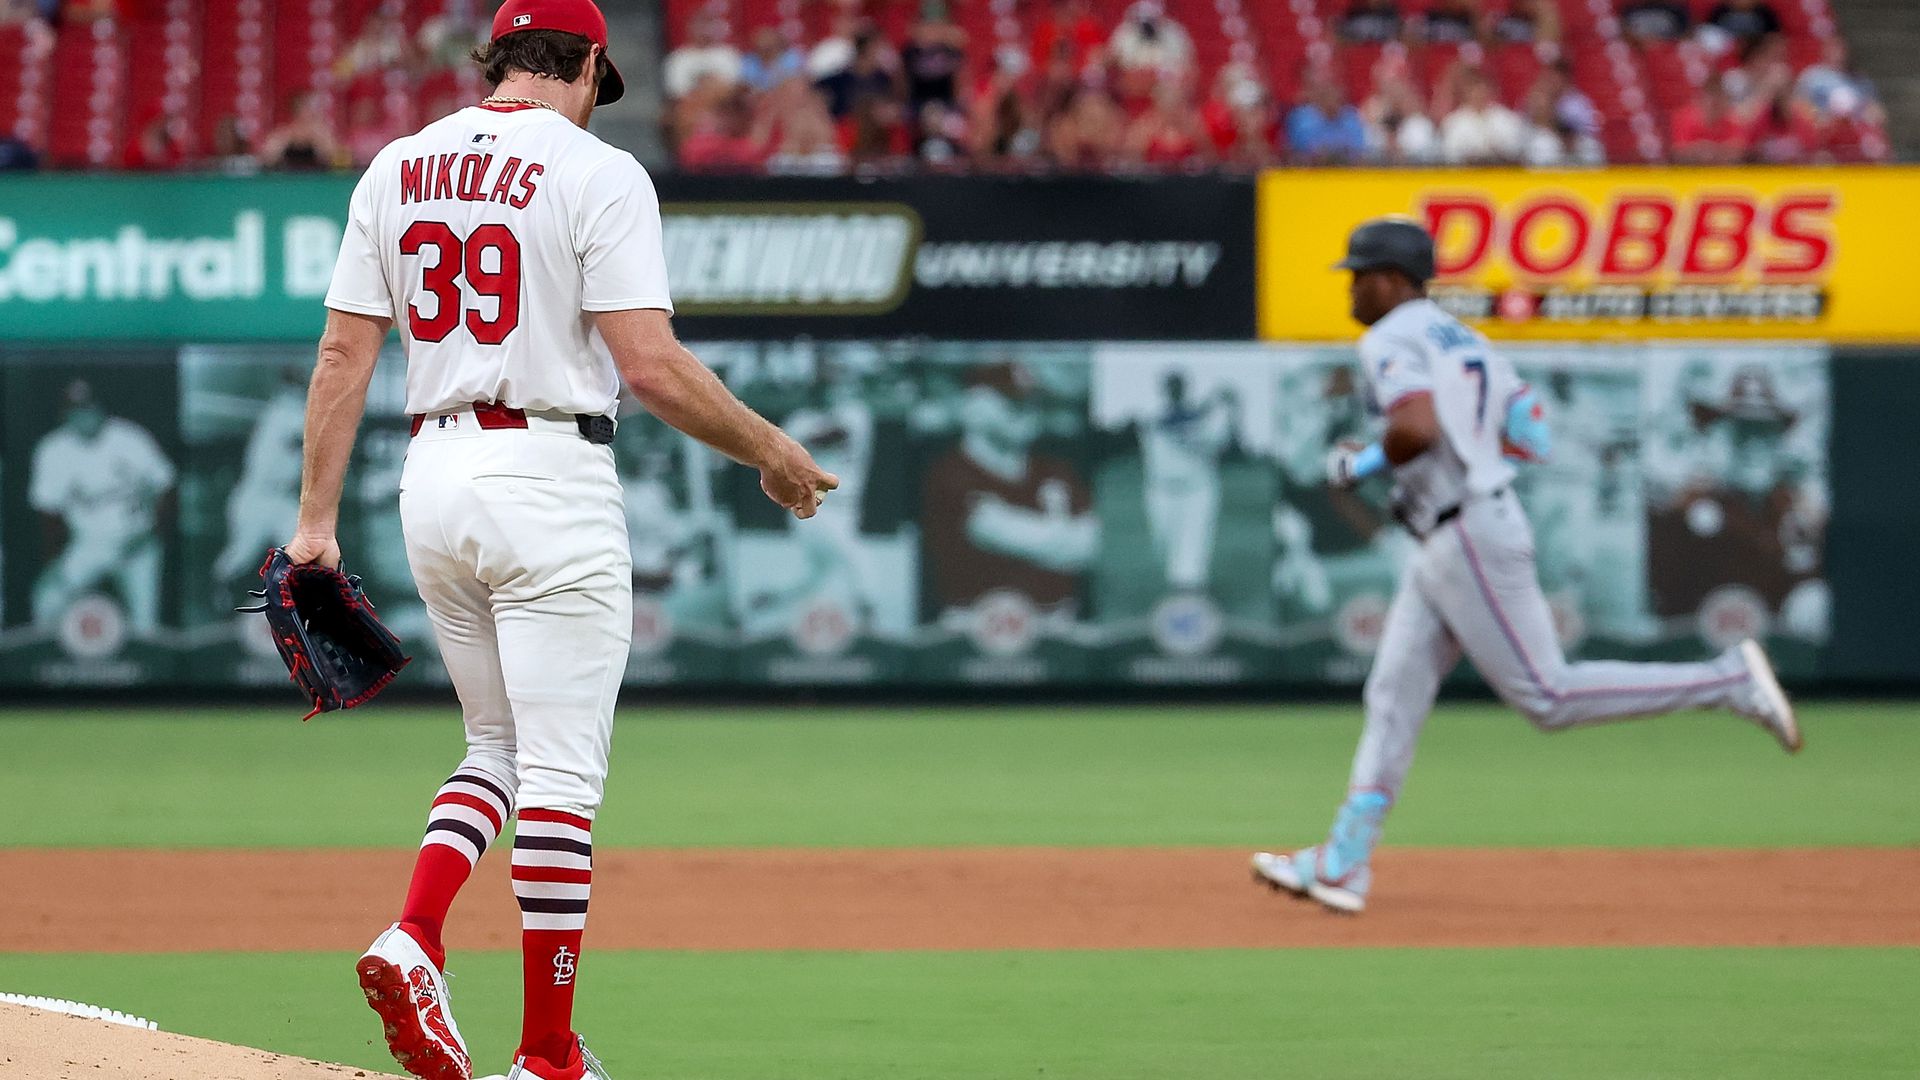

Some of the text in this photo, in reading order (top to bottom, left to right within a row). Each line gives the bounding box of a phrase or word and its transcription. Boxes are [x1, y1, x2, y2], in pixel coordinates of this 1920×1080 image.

[401, 153, 544, 209] MIKOLAS
[0, 209, 265, 300] entral
[914, 241, 1222, 288] UNIVERSITY
[1424, 197, 1832, 276] DOBBS
[400, 221, 520, 344] 39
[1463, 359, 1487, 428] 7
